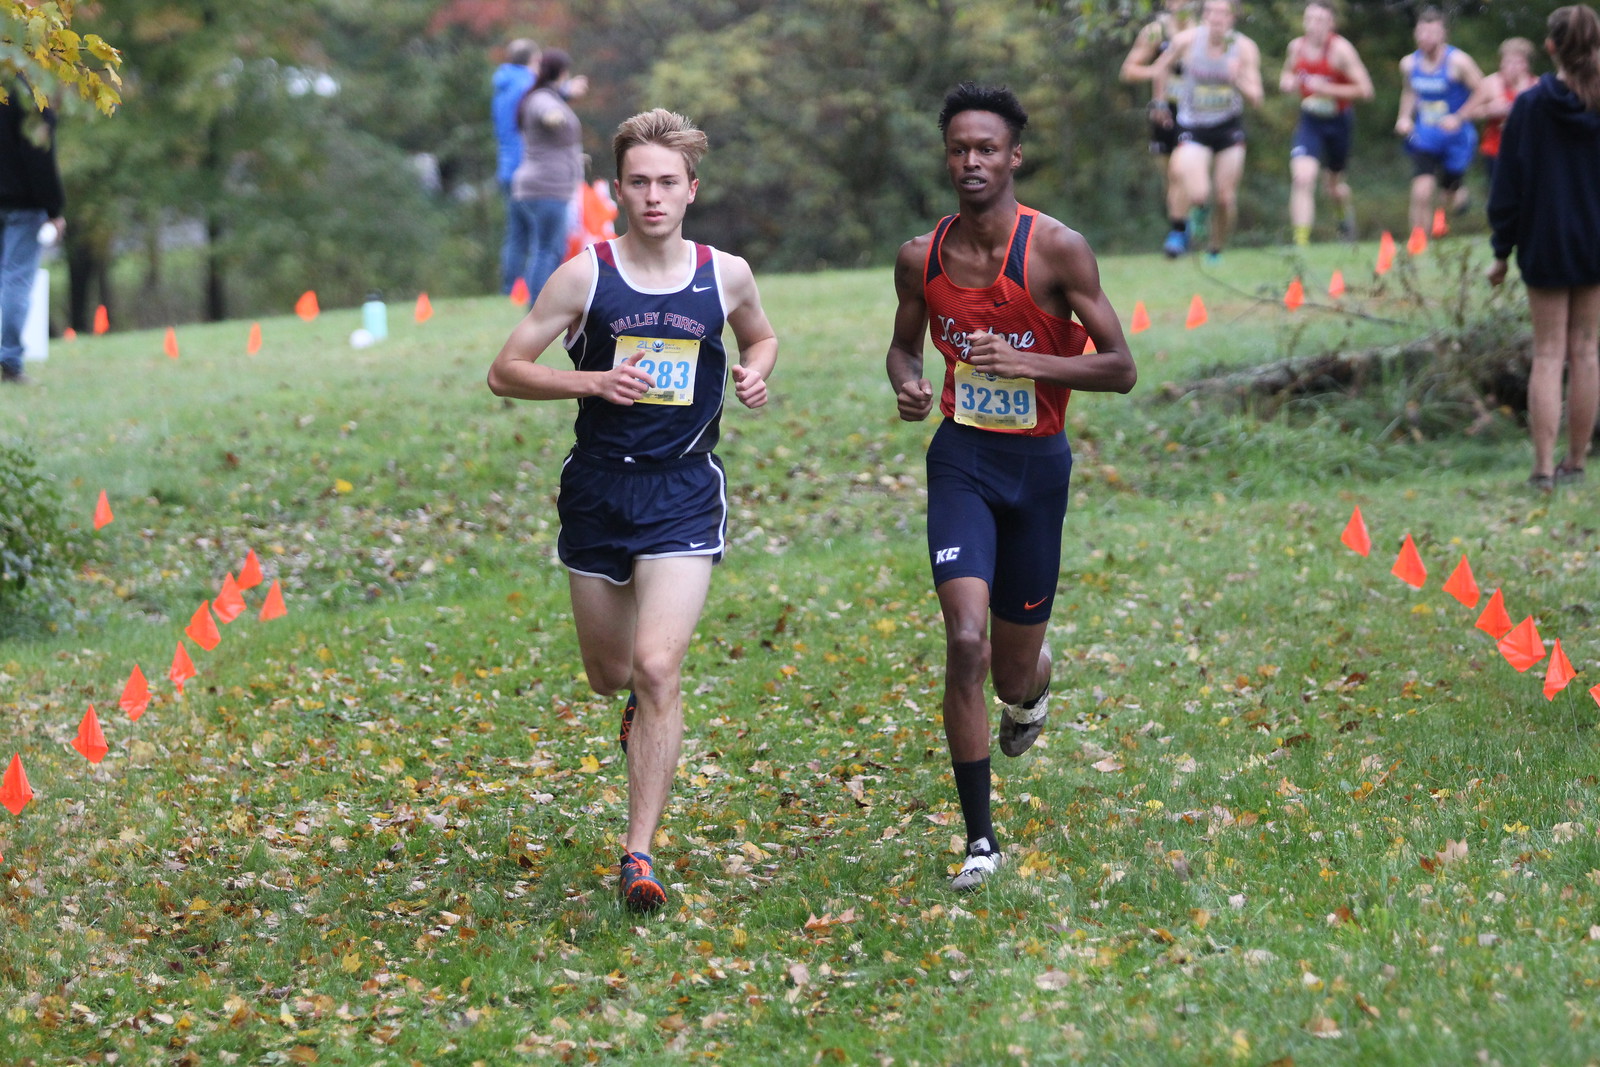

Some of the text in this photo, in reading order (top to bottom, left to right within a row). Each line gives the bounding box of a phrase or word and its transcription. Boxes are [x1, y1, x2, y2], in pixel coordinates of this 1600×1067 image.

[610, 312, 705, 336] VALLEY FORGE
[938, 314, 1035, 359] Keyne
[621, 357, 690, 389] 283
[961, 383, 1030, 415] 3239
[935, 547, 960, 564] KC
